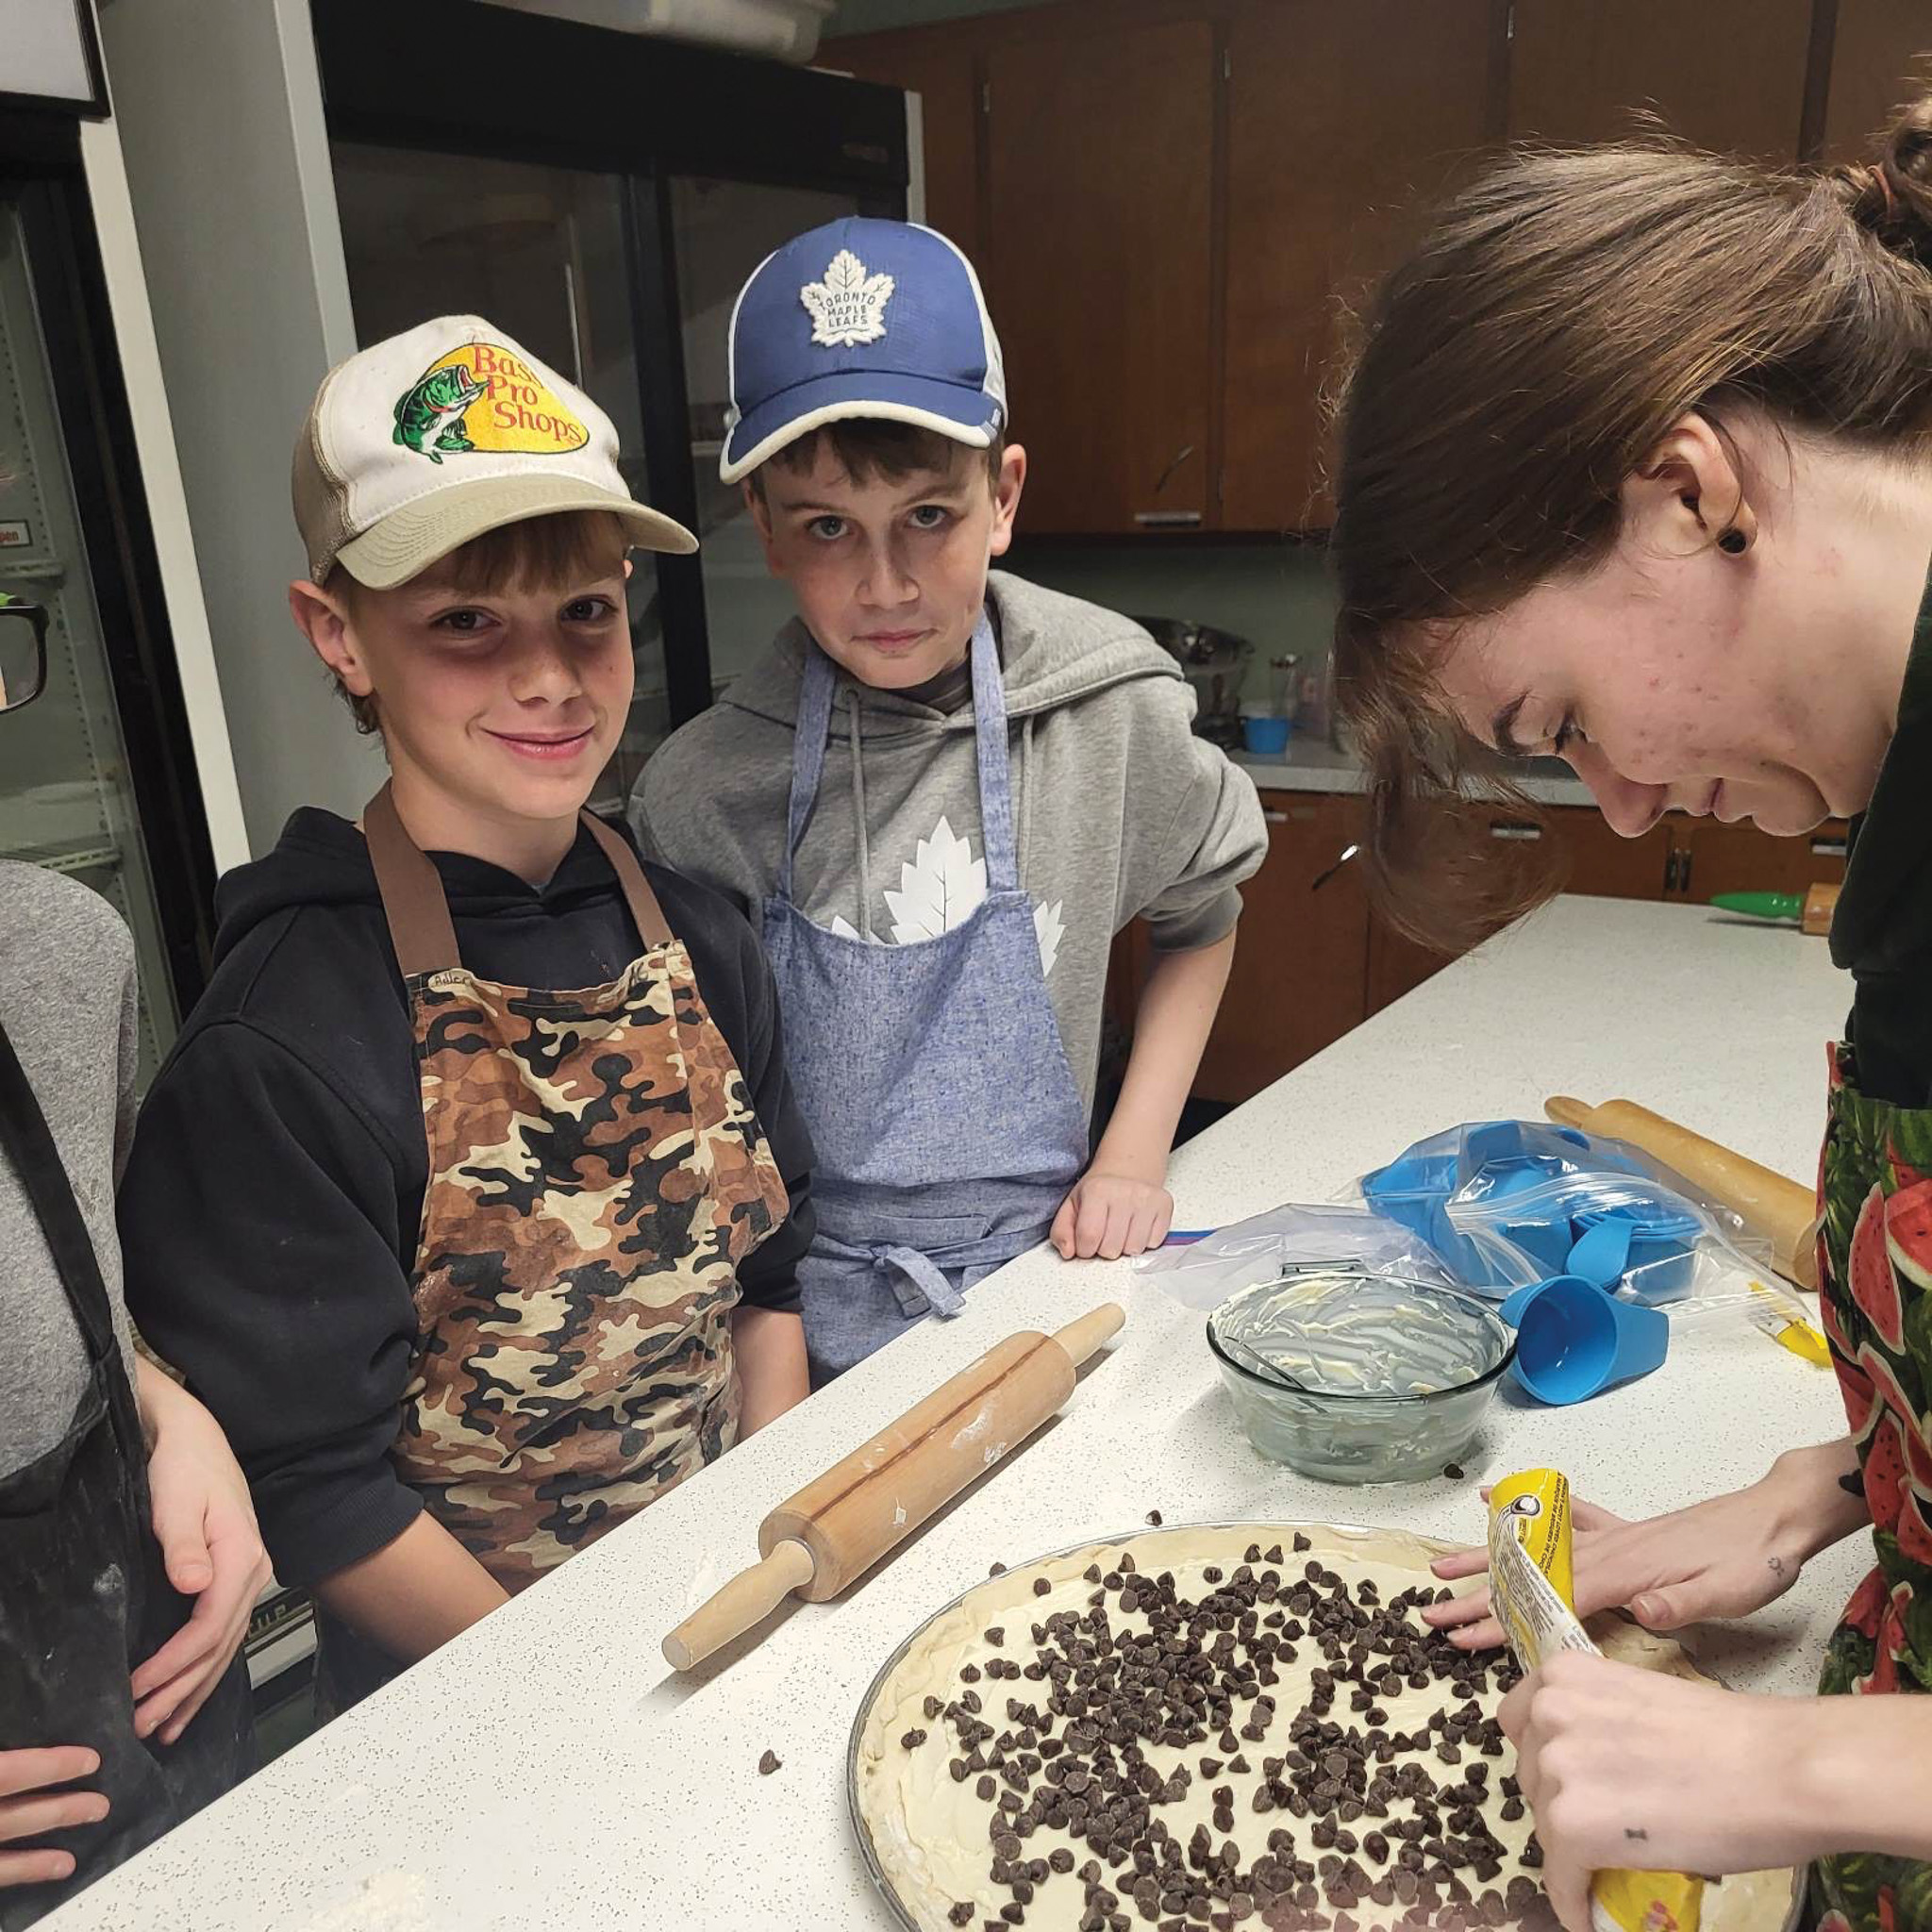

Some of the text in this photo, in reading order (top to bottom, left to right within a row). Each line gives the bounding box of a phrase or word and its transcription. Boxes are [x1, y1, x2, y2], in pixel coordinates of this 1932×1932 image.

[818, 291, 875, 310] TORONTO
[827, 305, 867, 316] MAPLE
[828, 315, 868, 328] LEAFS
[487, 375, 538, 406] Pro
[493, 401, 582, 443] Shops
